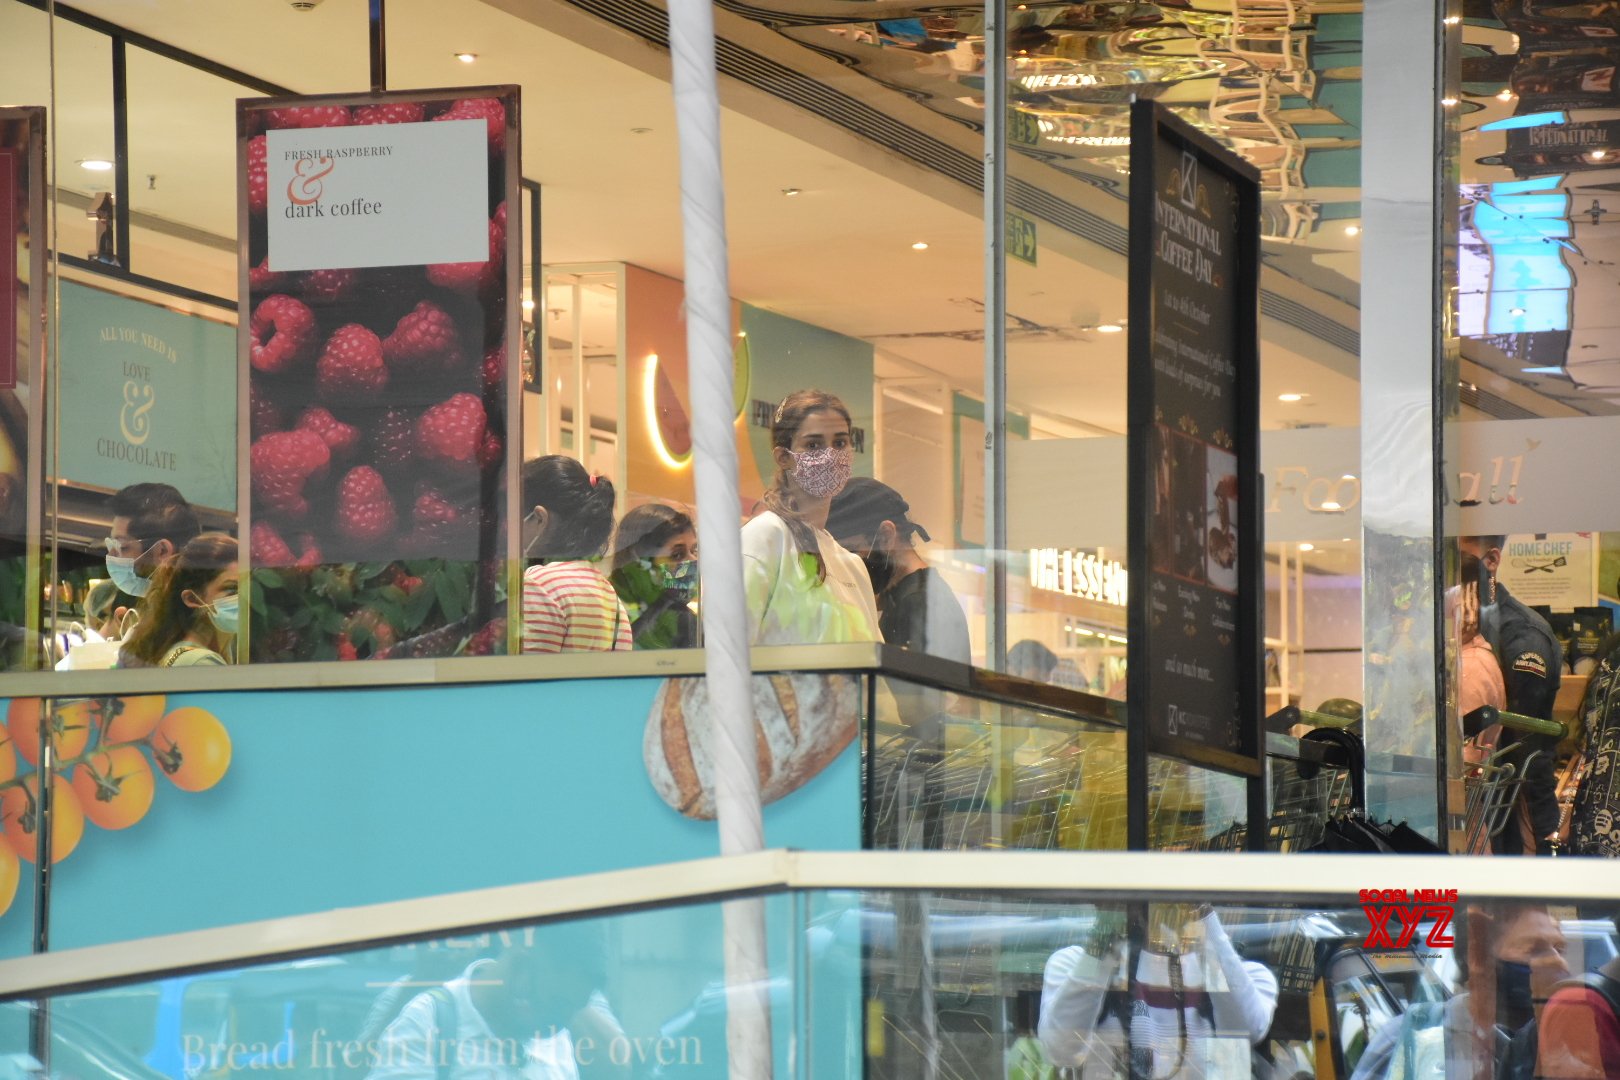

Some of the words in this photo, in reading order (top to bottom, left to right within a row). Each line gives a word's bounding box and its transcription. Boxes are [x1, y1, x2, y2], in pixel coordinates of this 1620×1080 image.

[284, 149, 321, 161] FRESH
[326, 145, 393, 159] RASPBERRY
[285, 199, 325, 219] dark
[330, 197, 382, 217] coffee
[101, 326, 117, 341] ALL
[119, 327, 138, 343] YOU
[141, 332, 166, 353] NEED
[123, 360, 151, 381] LOVE
[97, 438, 177, 472] CHOCOLATE
[1509, 541, 1542, 557] HOME
[1544, 541, 1573, 556] CHEF
[182, 1030, 295, 1072] Bread
[309, 1027, 408, 1069] fresh
[421, 1027, 517, 1067] from
[535, 1024, 595, 1065] the
[608, 1033, 704, 1066] oven
